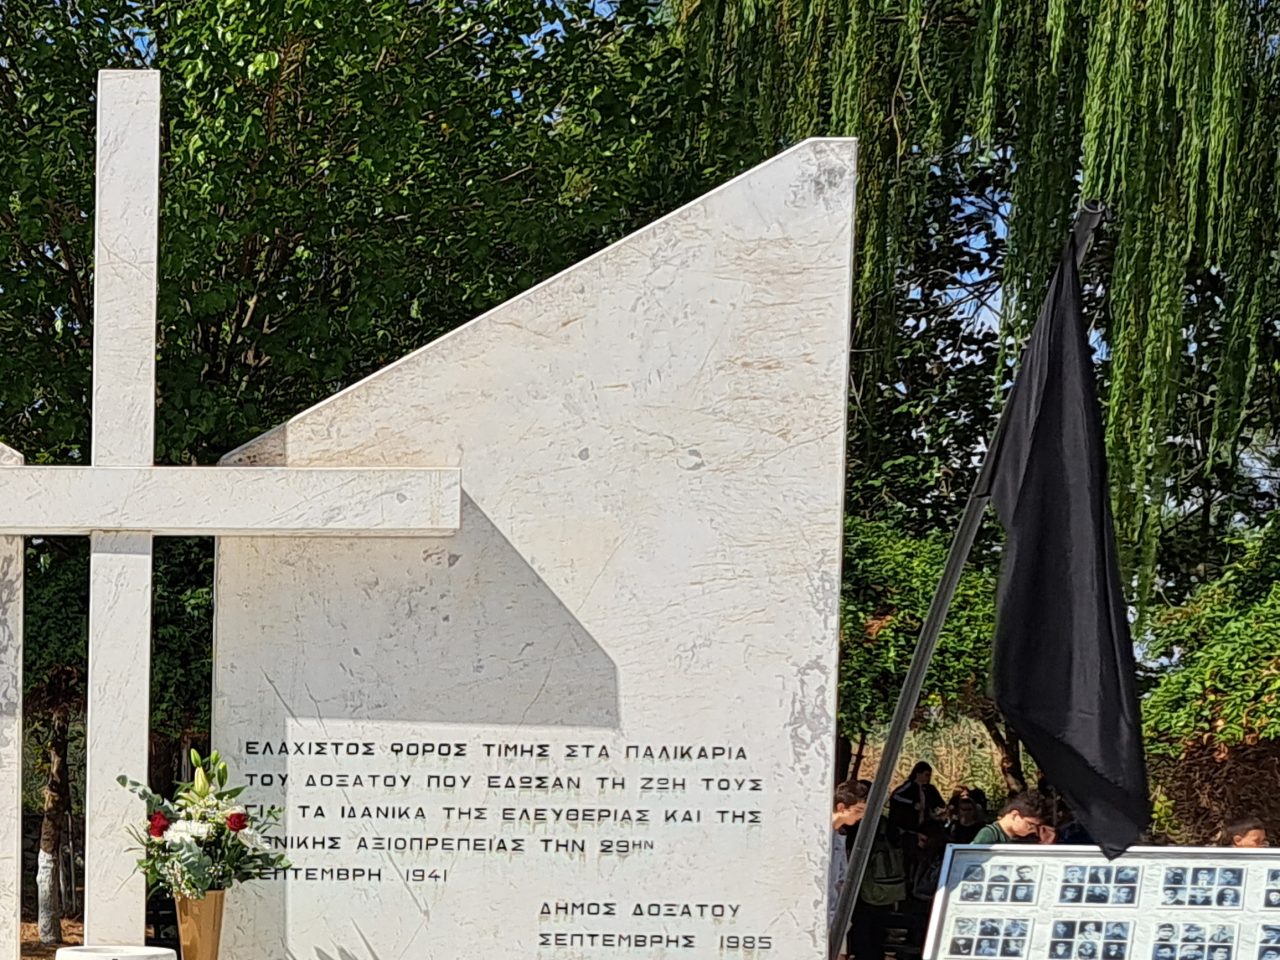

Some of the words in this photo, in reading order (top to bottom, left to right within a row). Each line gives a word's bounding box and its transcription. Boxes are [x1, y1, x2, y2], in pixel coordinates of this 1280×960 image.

[245, 741, 375, 756] ΕΛΑΧΙΣΤΟΣ
[390, 742, 467, 757] ΦΟΡΟΣ
[483, 743, 550, 758] ΤΙΜΗΣ
[565, 744, 610, 759] ΣΤΑ
[625, 745, 747, 760] ΠΑΛΙΚΑΡΙΑ
[245, 773, 288, 787] ΤΟΥ
[305, 774, 411, 788] ΔΟΞΑΤΟΥ
[427, 775, 471, 788] ΠΟΥ
[487, 775, 580, 789] ΕΔΩΣΑΝ
[596, 777, 625, 790] ΤΗ
[640, 777, 686, 790] ΖΩΗ
[701, 778, 762, 791] ΤΟΥΣ
[244, 804, 276, 818] ΓΙ
[298, 805, 325, 818] ΤΑ
[341, 806, 426, 819] ΙΔΑΝΙΚΑ
[442, 807, 487, 820] ΤΗΣ
[502, 807, 649, 822] ΕΛΕΥΘΕΡΙΑΣ
[664, 809, 701, 823] ΚΑΙ
[716, 810, 761, 824] ΤΗΣ
[356, 836, 525, 852] ΑΞΙΟΠΡΕΠΕΙΑΣ
[540, 838, 585, 853] ΤΗΝ
[257, 866, 381, 881] ΕΠΤΕΜΒΡΗ
[406, 868, 447, 882] 1941
[540, 902, 616, 916] ΔΗΜΟΣ
[632, 903, 739, 917] ΔΟΞΑΤΟΥ
[539, 933, 695, 948] ΣΕΠΤΕΜΒΡΗΣ
[720, 935, 772, 950] 1985
